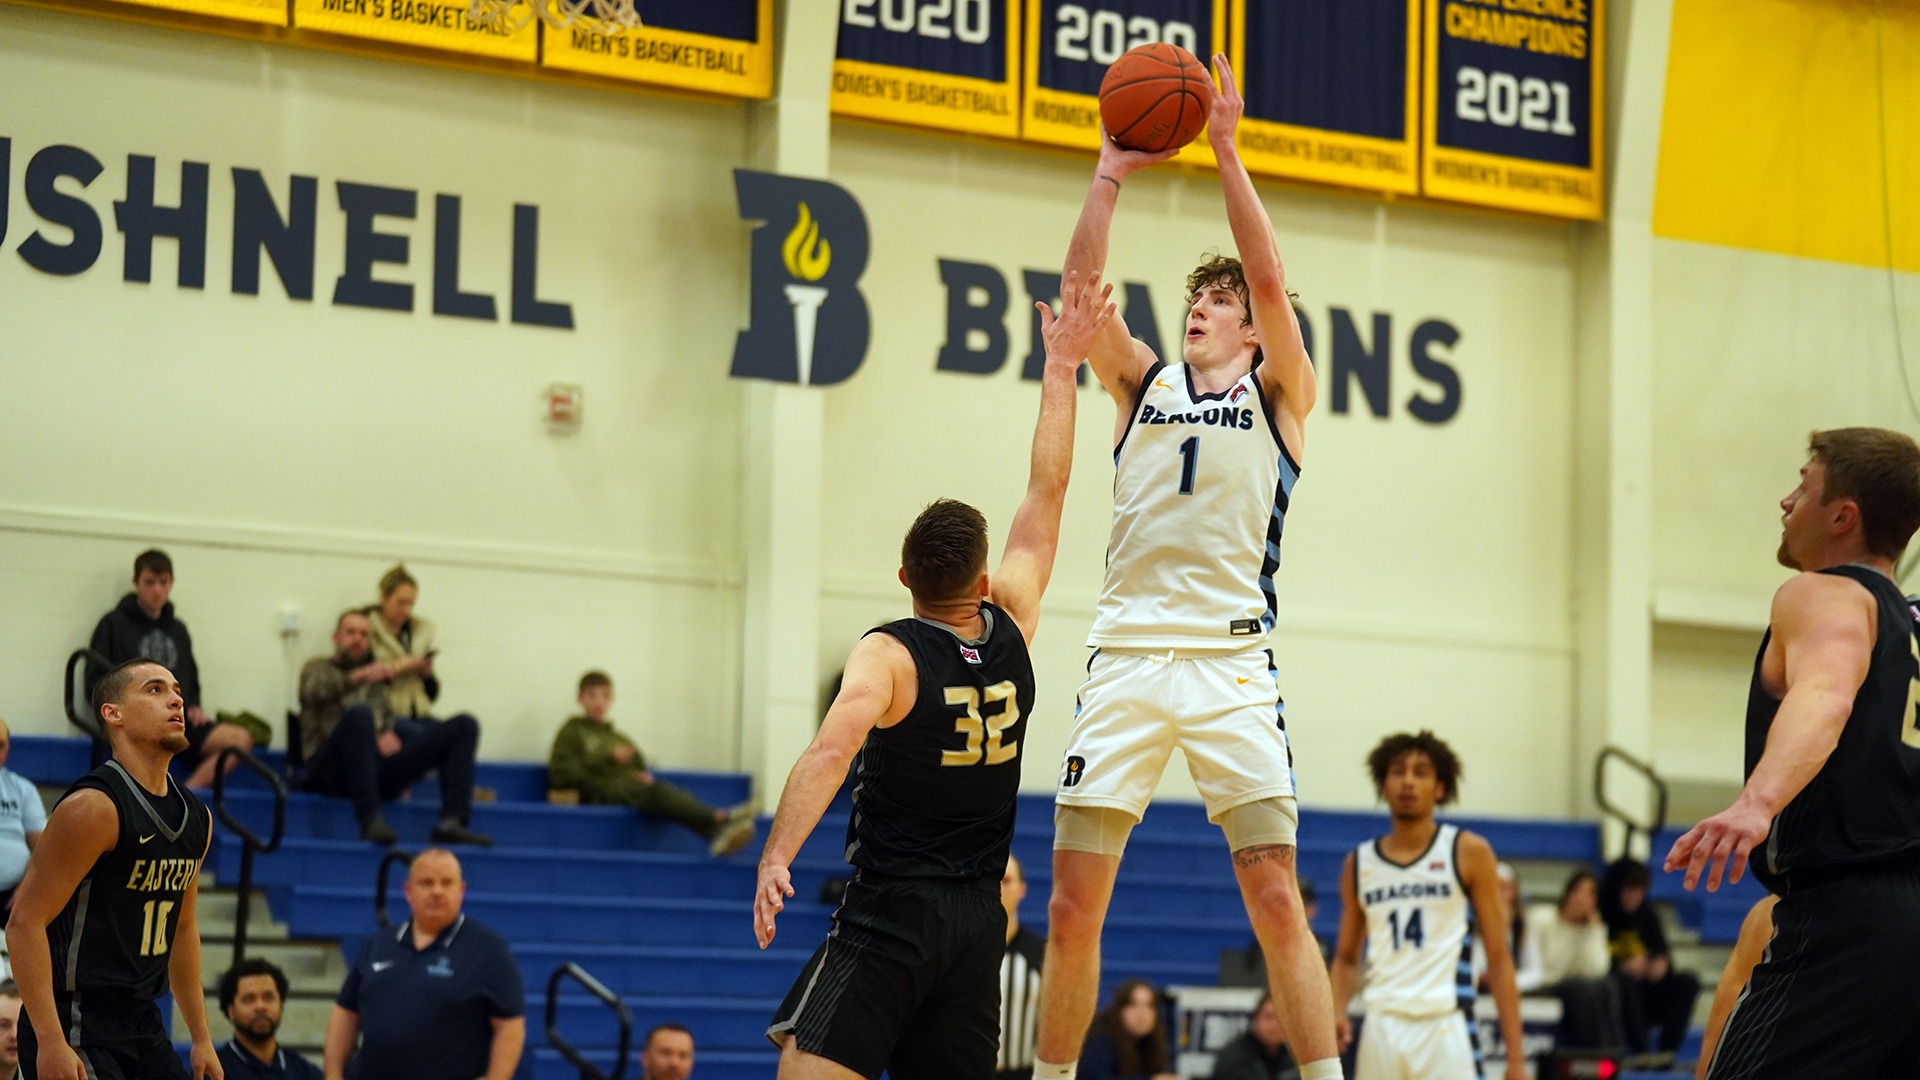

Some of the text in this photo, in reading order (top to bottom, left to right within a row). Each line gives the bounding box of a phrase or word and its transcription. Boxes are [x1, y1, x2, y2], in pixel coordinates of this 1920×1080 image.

[571, 29, 747, 76] MEN'S BASKETBALL
[1445, 2, 1587, 59] CHAMPIONS
[834, 72, 1010, 116] OMEN'S BASKETBALL
[1456, 66, 1576, 137] 2021
[0, 136, 575, 330] SHNELL
[1178, 435, 1200, 495] 1
[940, 679, 1021, 767] 32
[1364, 883, 1451, 906] BEACONS
[140, 900, 175, 956] 10
[1388, 908, 1424, 951] 14
